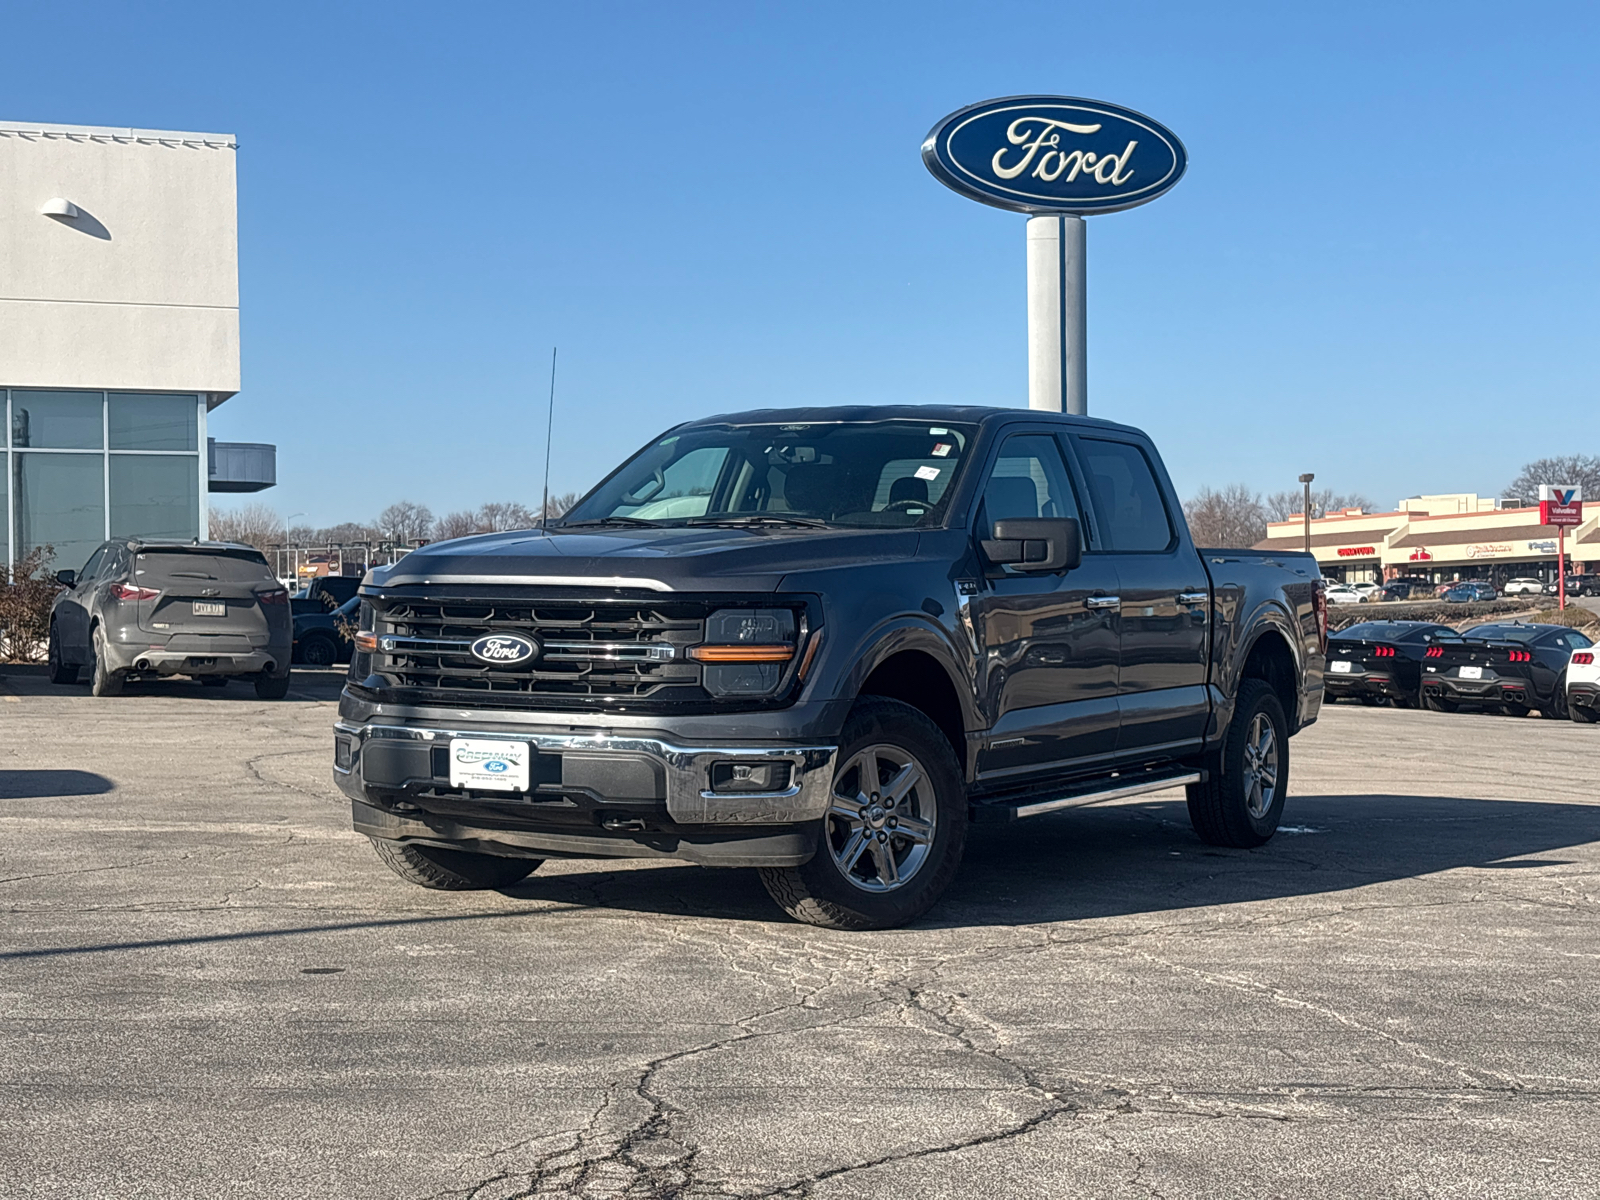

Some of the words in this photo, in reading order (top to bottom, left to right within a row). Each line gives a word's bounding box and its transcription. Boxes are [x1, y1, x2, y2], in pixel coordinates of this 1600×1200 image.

[992, 117, 1138, 186] Ford
[1551, 507, 1577, 515] Valvoline
[483, 639, 521, 658] Ford
[488, 762, 504, 771] Ford
